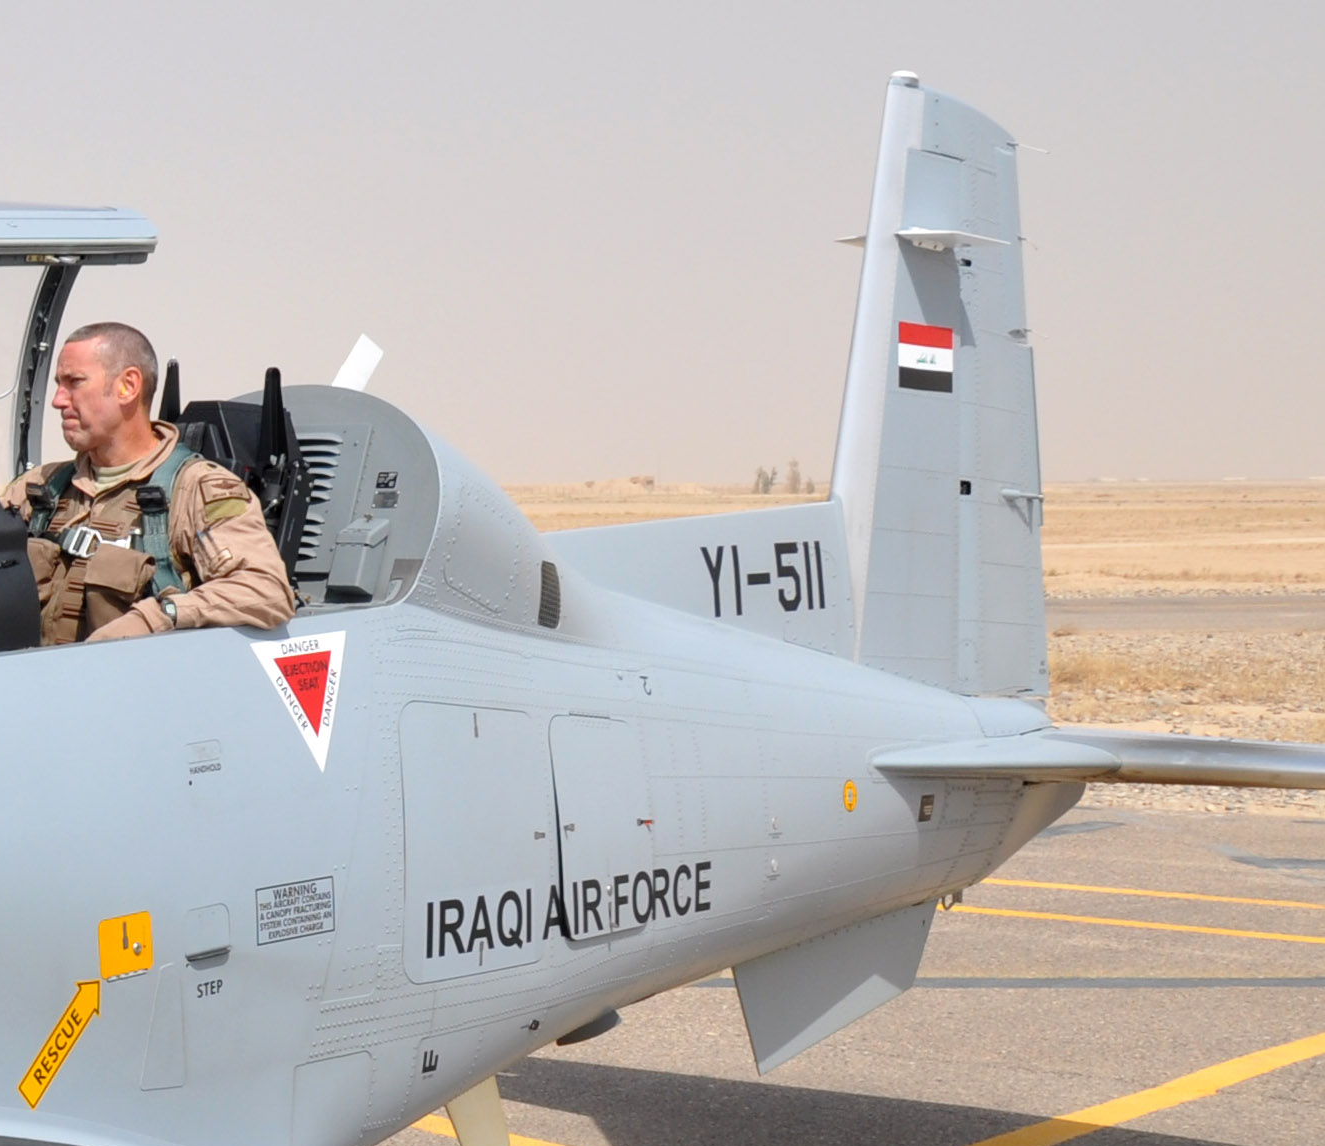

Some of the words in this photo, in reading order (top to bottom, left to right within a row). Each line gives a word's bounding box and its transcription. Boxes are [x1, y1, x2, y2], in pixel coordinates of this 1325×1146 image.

[700, 541, 825, 617] YI-511
[280, 639, 319, 655] DANGER
[283, 660, 328, 677] EJECTION
[297, 677, 319, 691] SEAT
[276, 676, 308, 731] DANGER
[322, 669, 337, 727] DANGER
[273, 883, 317, 899] WARNING
[259, 901, 272, 911] THIS
[273, 896, 300, 908] AIRCRAFT
[301, 891, 331, 904] CONTAINS
[266, 908, 291, 920] CANOPY
[293, 900, 331, 914] FRACTURING
[426, 888, 532, 959] IRAQI
[542, 879, 603, 940] AIR
[614, 861, 711, 927] FORCE
[260, 921, 281, 931] SYSTEM
[283, 912, 321, 926] CONTAINING
[268, 927, 298, 939] EXPLOSIVE
[299, 922, 324, 933] CHARGE
[196, 979, 223, 998] STEP
[33, 1009, 82, 1085] RESCUE
